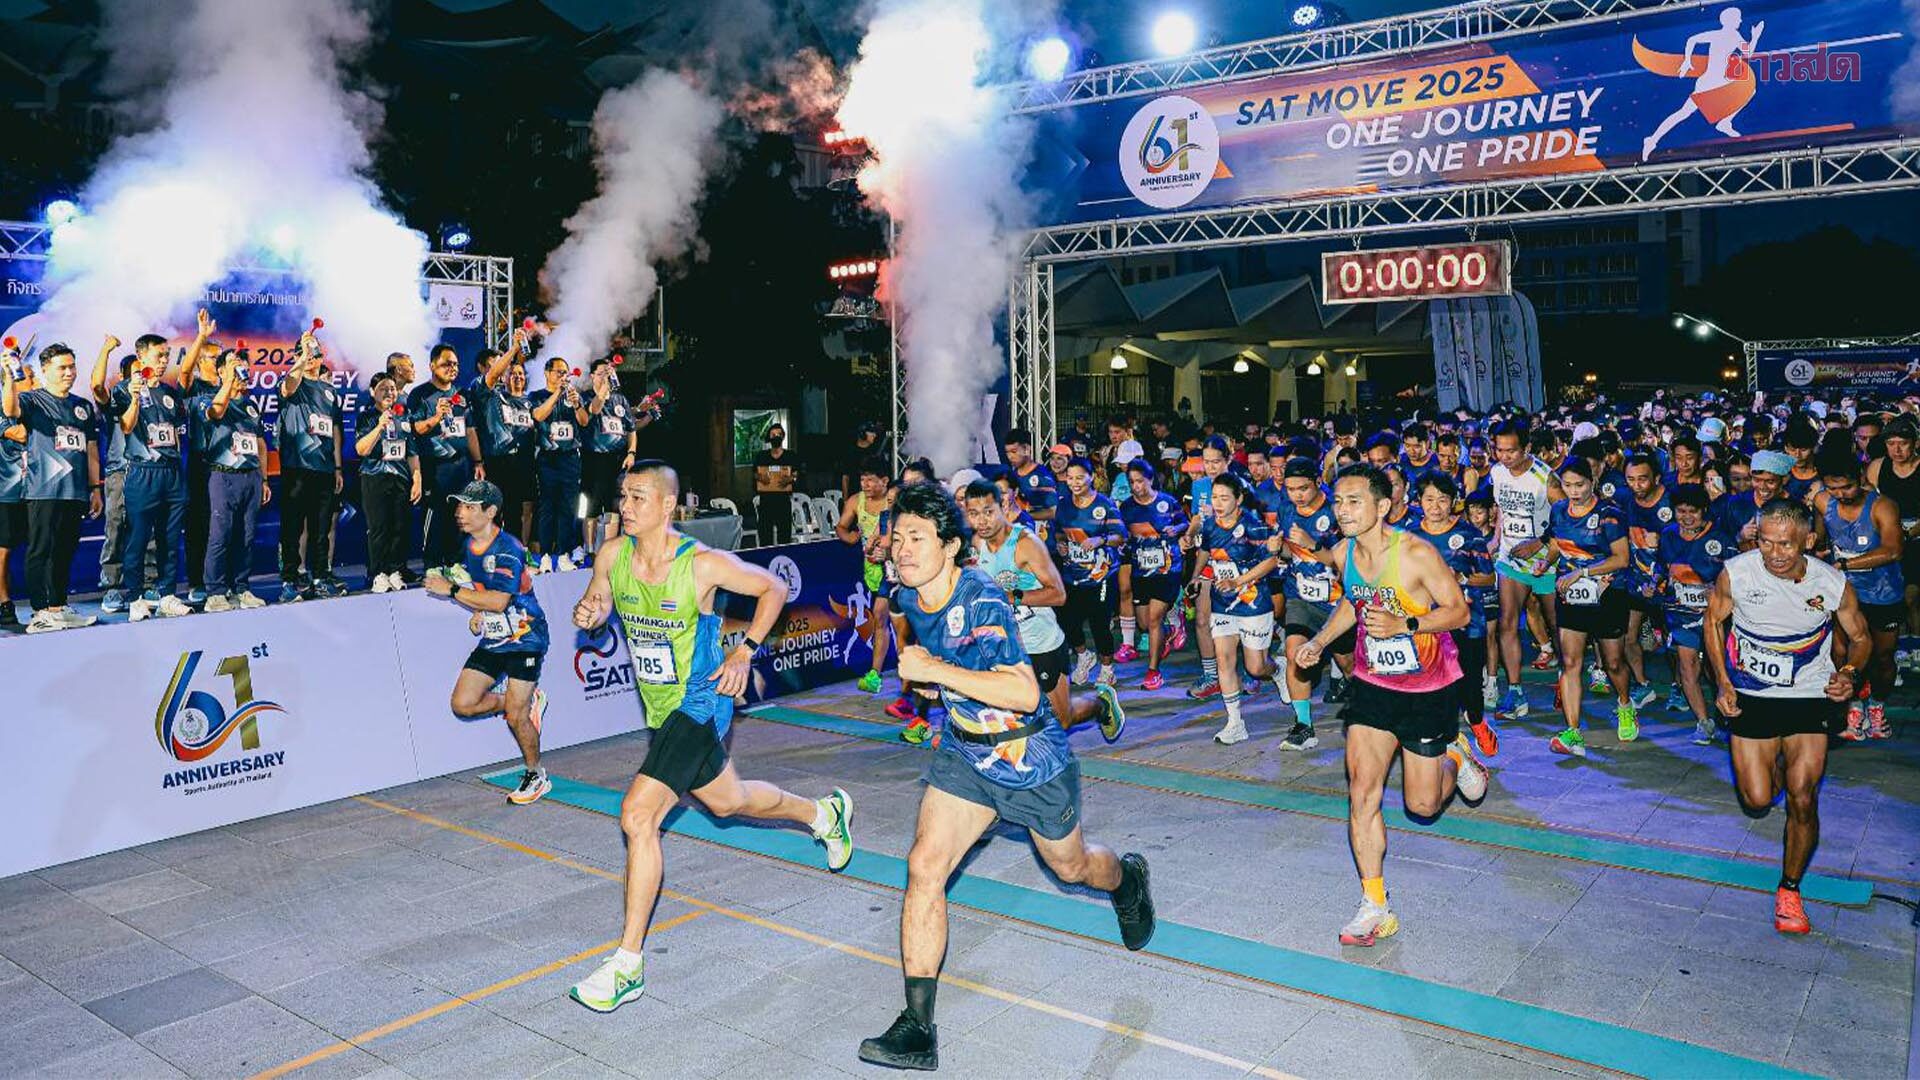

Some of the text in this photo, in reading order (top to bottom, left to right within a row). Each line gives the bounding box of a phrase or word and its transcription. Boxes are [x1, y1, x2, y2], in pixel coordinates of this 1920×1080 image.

[1236, 63, 1506, 126] SAT MOVE 2025
[1326, 87, 1604, 150] ONE JOURNEY
[1387, 126, 1602, 178] ONE PRIDE
[1140, 172, 1201, 187] ANNIVERSARY
[1340, 252, 1486, 293] 0:00:00
[519, 414, 529, 425] 61
[610, 420, 619, 431] 61
[319, 421, 330, 433] 61
[558, 427, 569, 438] 61
[67, 434, 80, 447] 61
[159, 430, 171, 442] 61
[241, 439, 253, 450] 61
[390, 446, 401, 456] 61
[1508, 522, 1526, 533] 484
[1073, 549, 1089, 560] 645
[1302, 583, 1320, 597] 321
[1568, 588, 1590, 600] 230
[1684, 592, 1705, 603] 189
[787, 617, 810, 634] 025
[779, 628, 837, 654] JOURNEY
[636, 656, 663, 674] 785
[773, 644, 840, 672] ONE PRIDE
[1377, 650, 1406, 666] 409
[1749, 656, 1780, 678] 210
[584, 663, 633, 692] SAT
[162, 751, 286, 789] ANNIVERSARY
